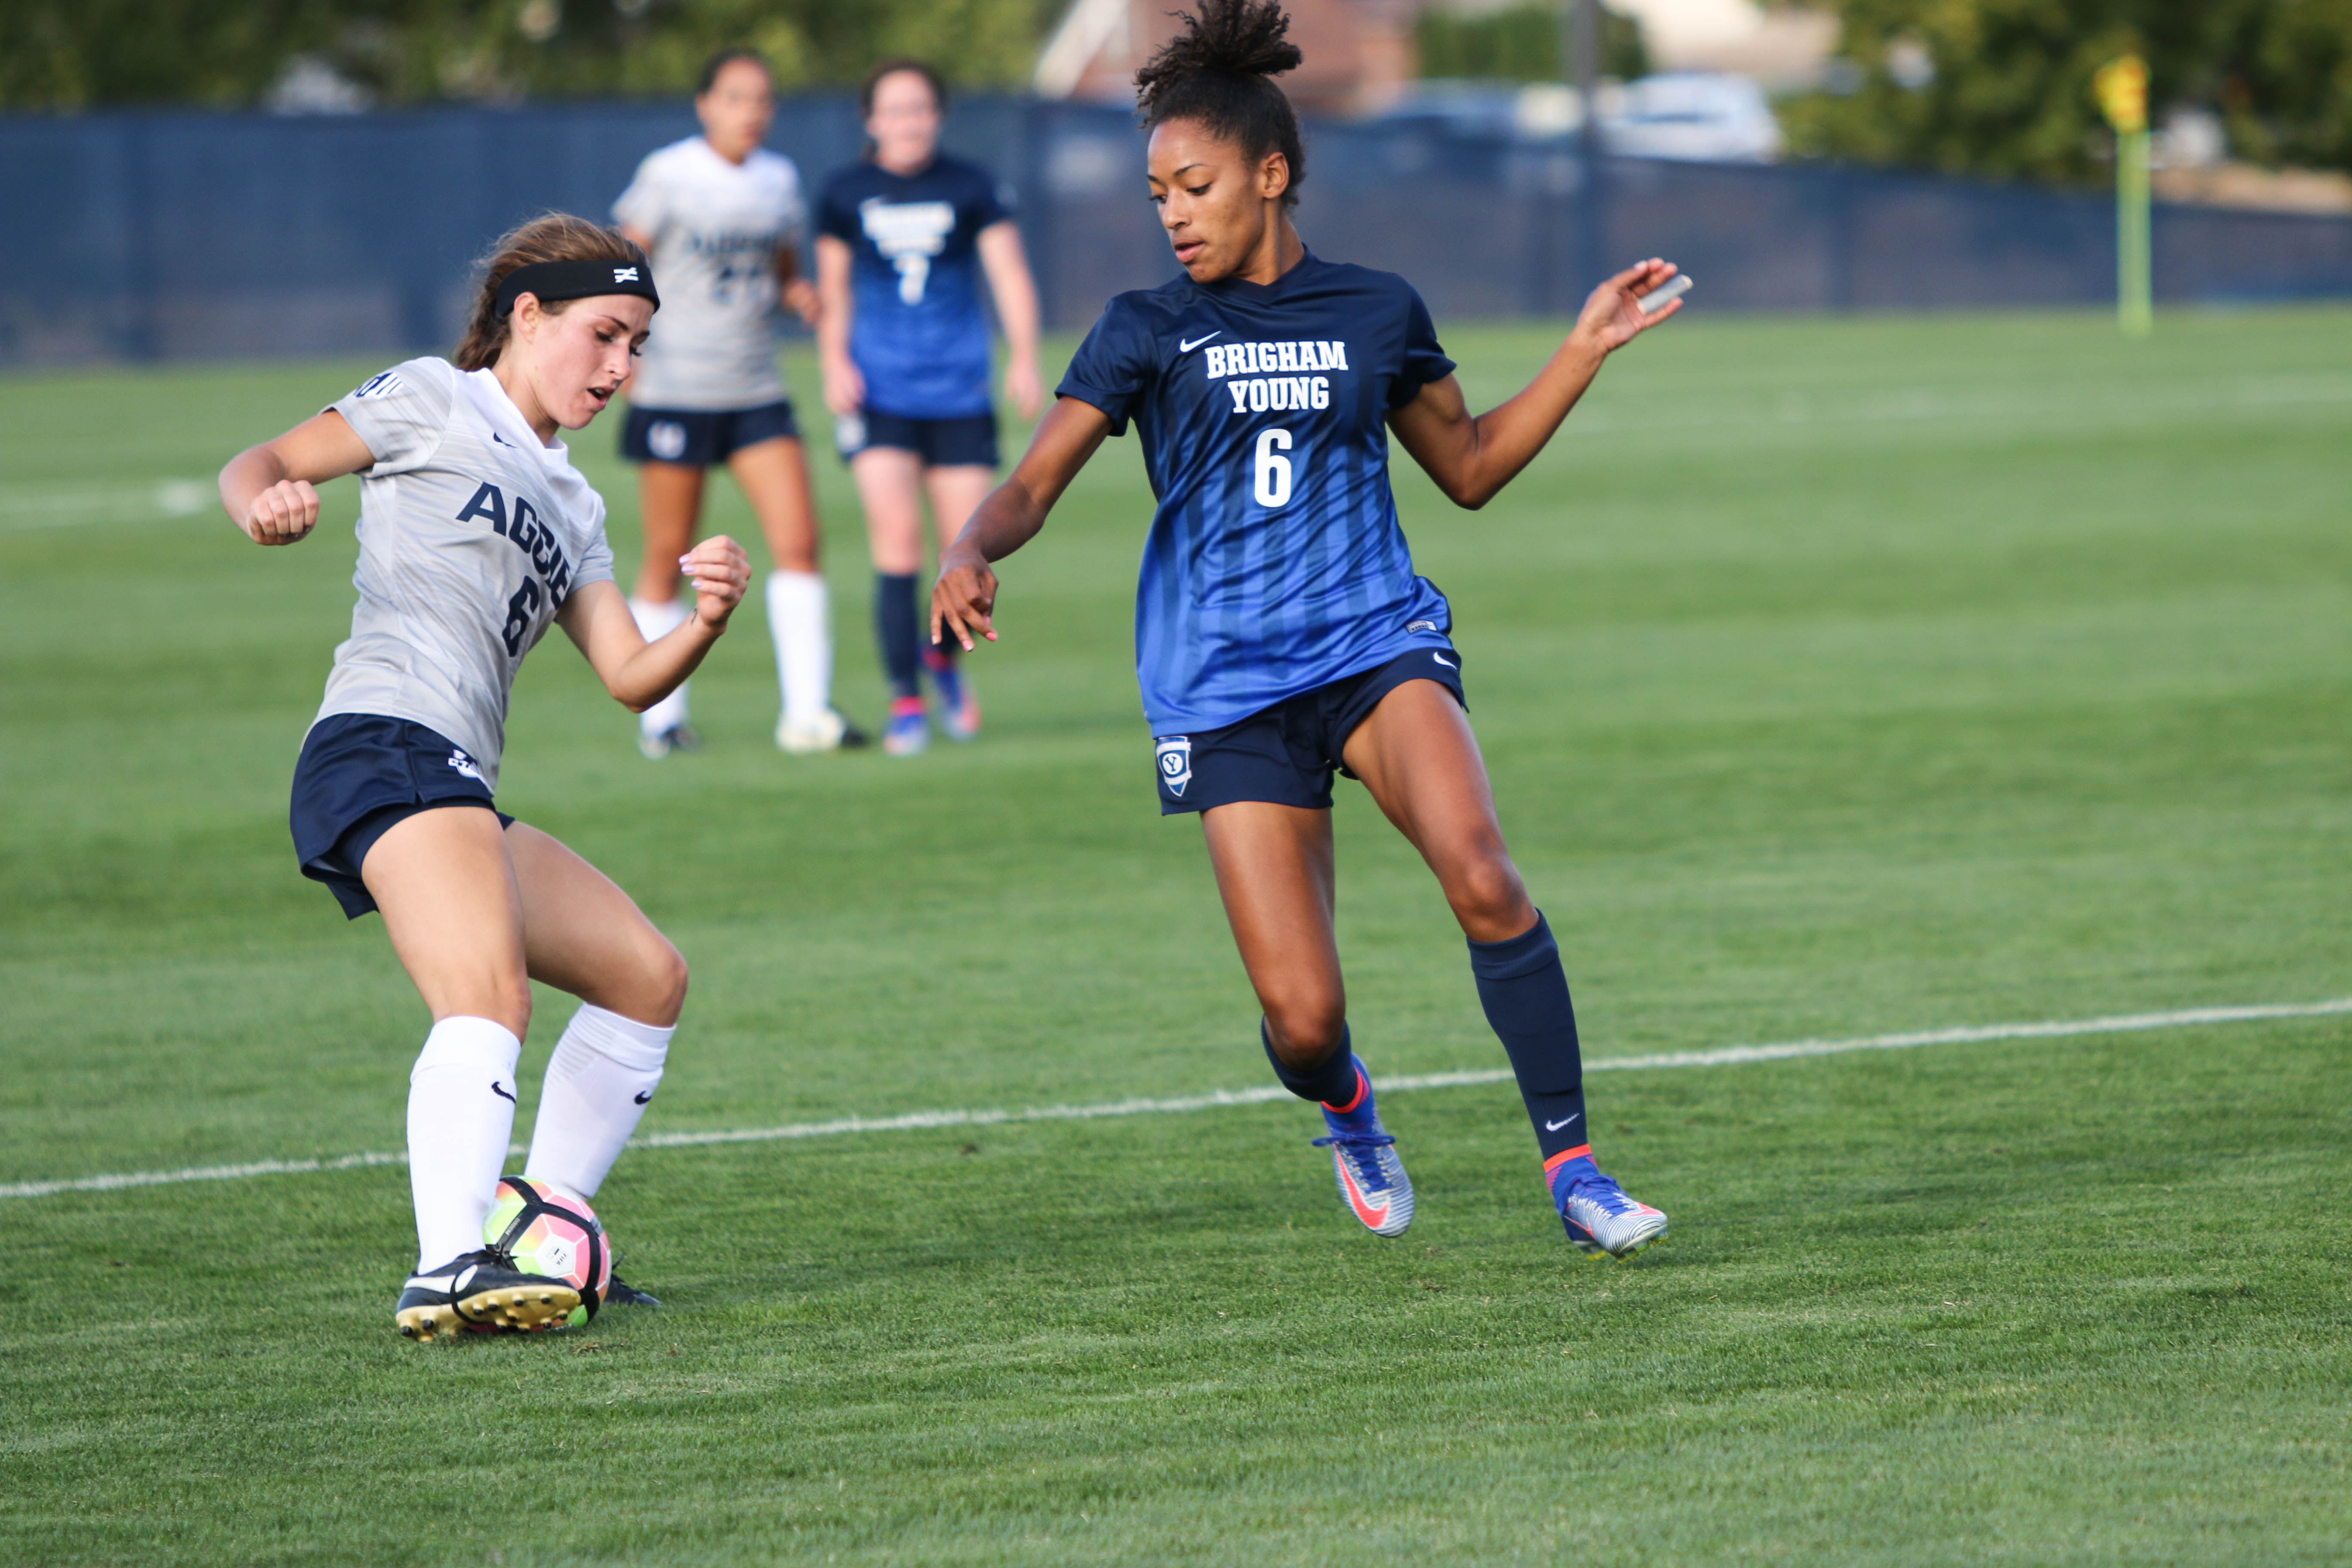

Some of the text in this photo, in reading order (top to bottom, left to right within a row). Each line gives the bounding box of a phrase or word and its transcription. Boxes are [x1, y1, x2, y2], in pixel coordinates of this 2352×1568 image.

[1205, 341, 1349, 379] BRIGHAM
[1228, 377, 1329, 413] YOUNG
[1254, 428, 1292, 508] 6
[502, 575, 539, 657] 6
[1165, 756, 1176, 772] Y
